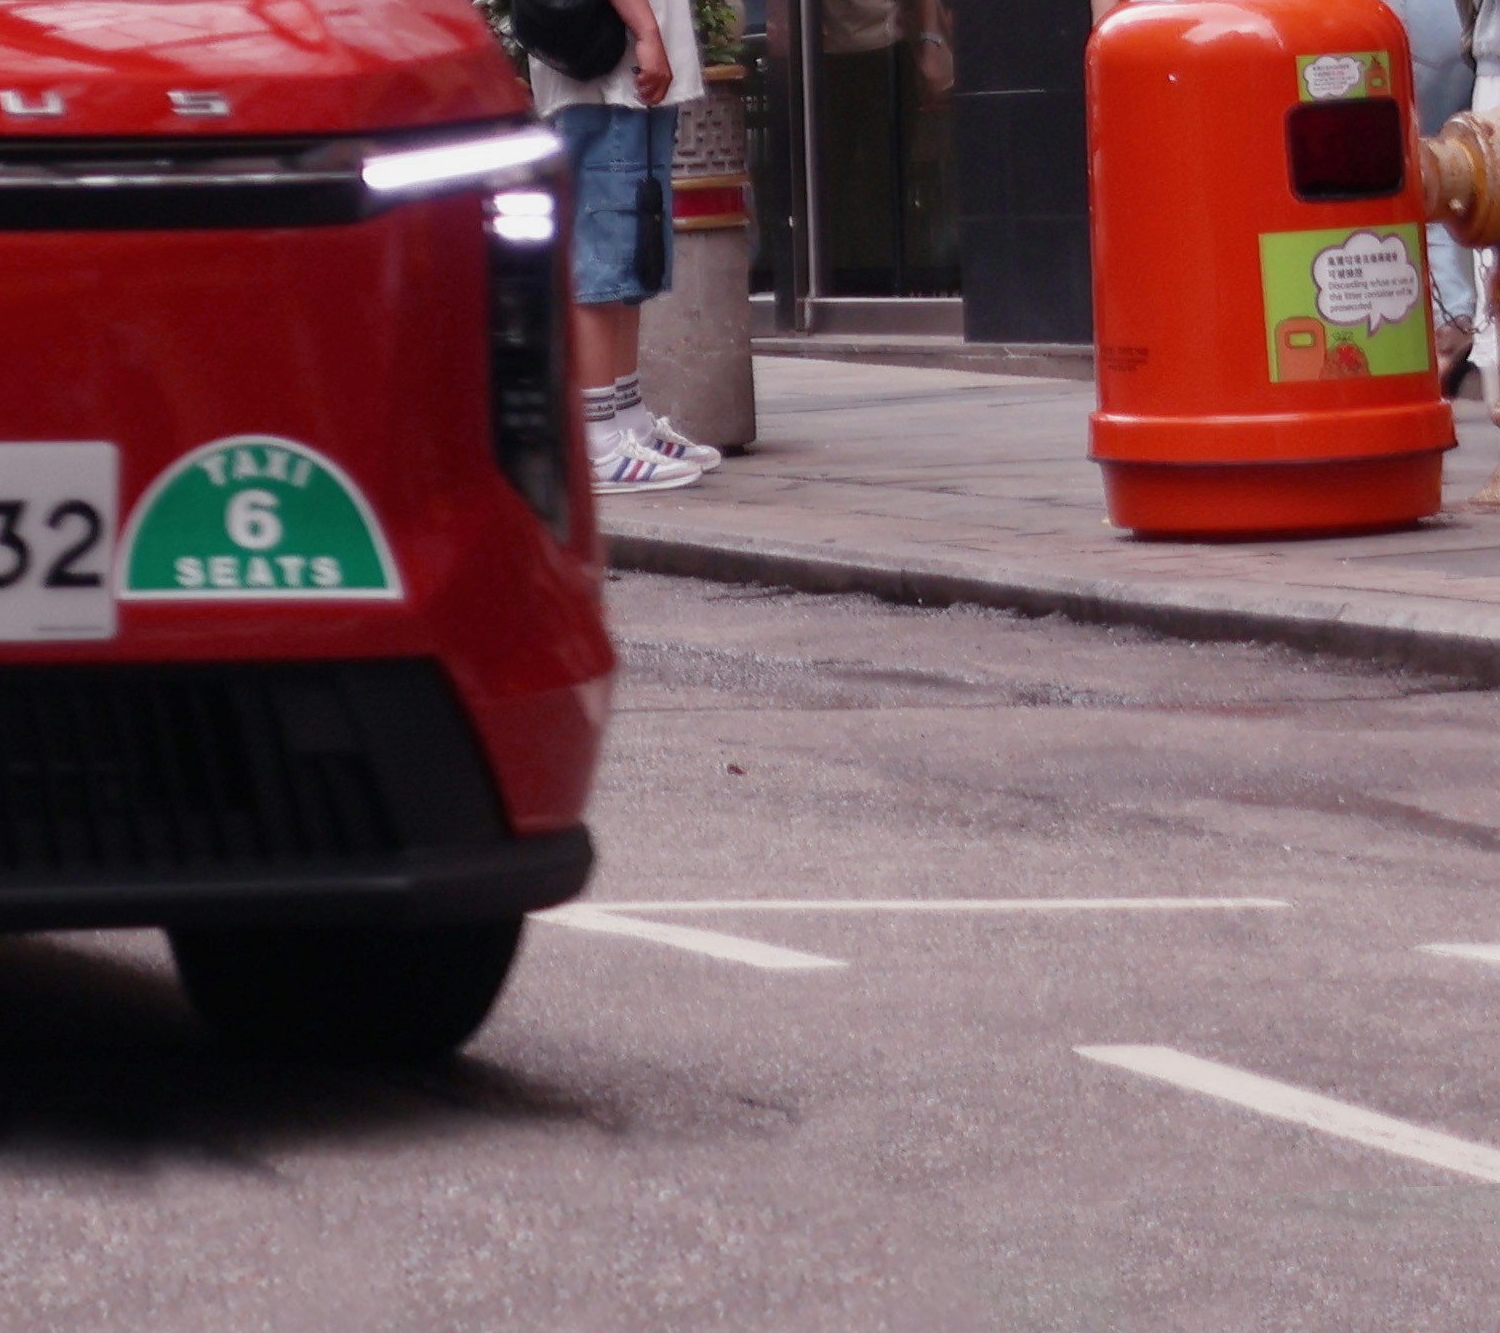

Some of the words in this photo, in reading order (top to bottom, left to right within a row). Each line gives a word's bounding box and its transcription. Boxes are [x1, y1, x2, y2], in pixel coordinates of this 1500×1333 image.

[1328, 281, 1368, 290] Discarding
[199, 448, 314, 489] TAXI
[225, 488, 283, 550] 6
[173, 555, 344, 589] SEATS
